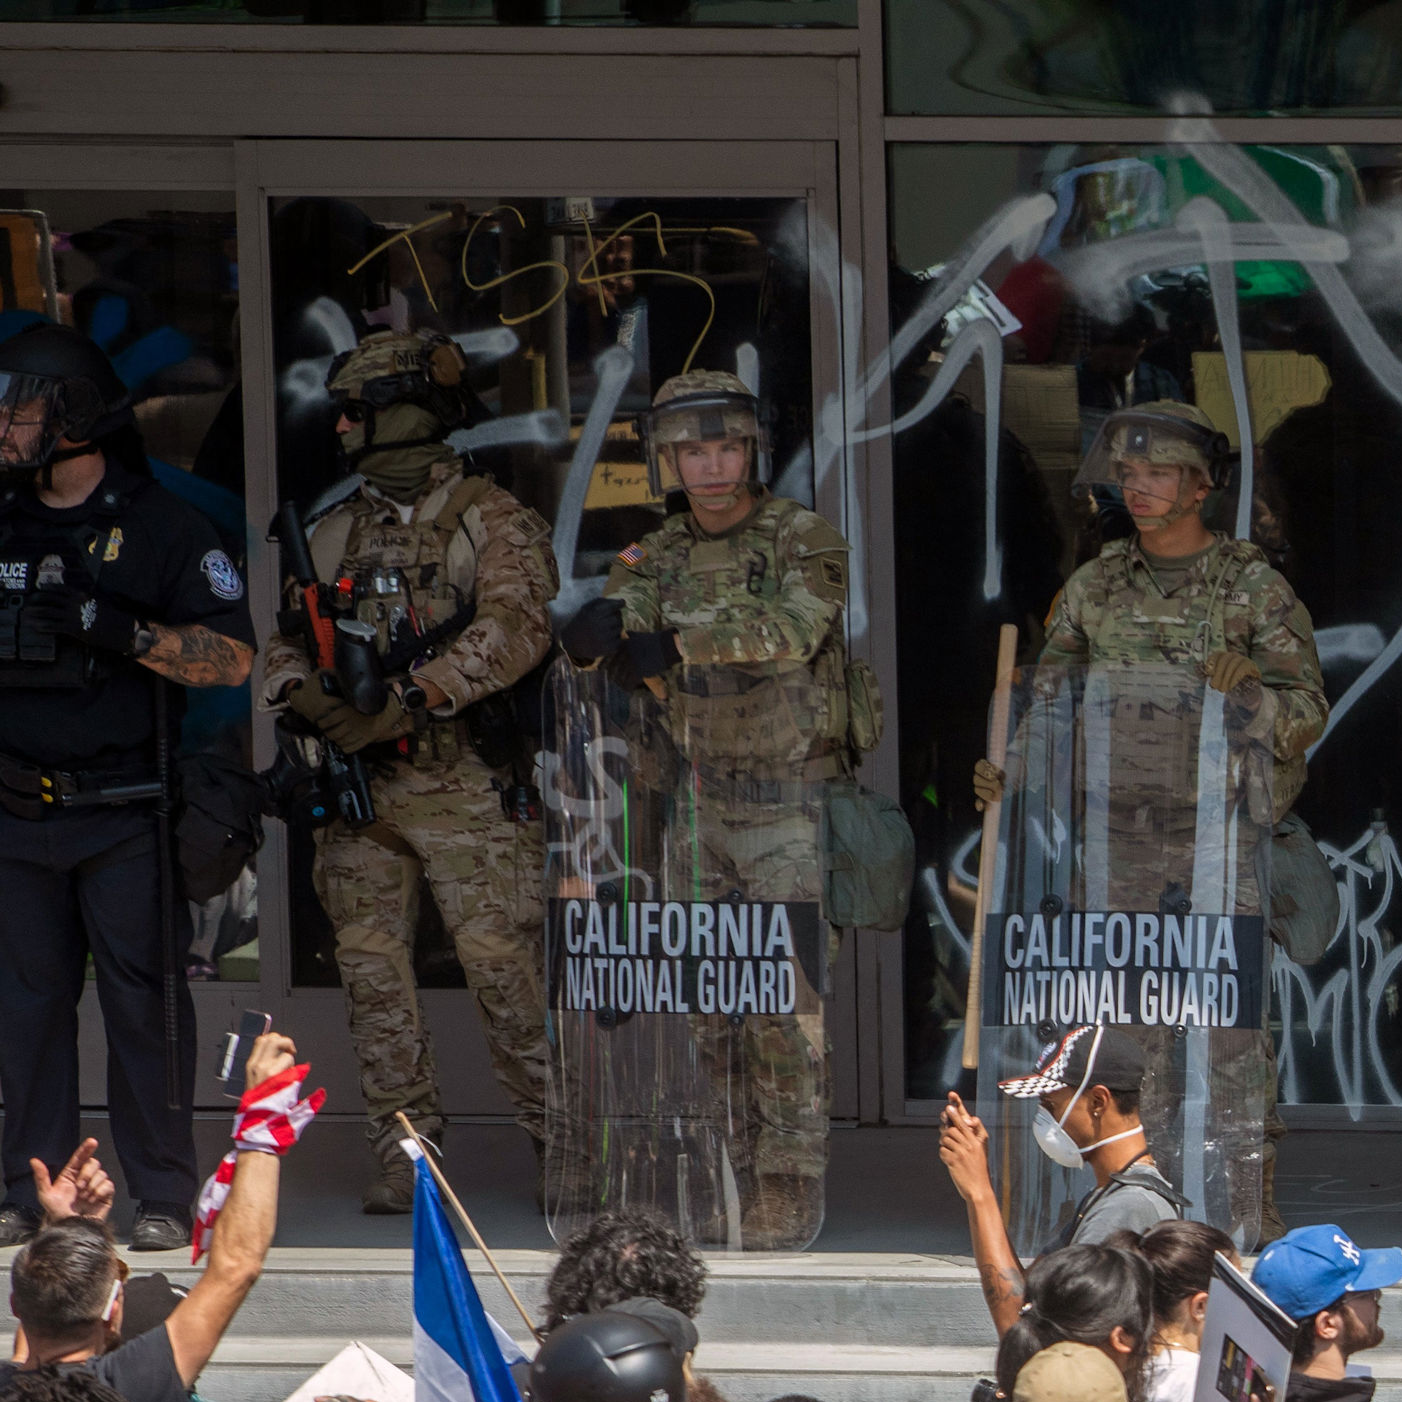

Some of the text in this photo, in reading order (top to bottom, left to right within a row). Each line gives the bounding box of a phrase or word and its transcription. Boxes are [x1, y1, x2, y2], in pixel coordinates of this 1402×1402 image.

[0, 562, 27, 577] OLICE
[565, 902, 794, 958] CALIFORNIA
[1004, 913, 1238, 970] CALIFORNIA
[566, 959, 796, 1015] NATIONAL GUARD
[1003, 971, 1239, 1028] NATIONAL GUARD
